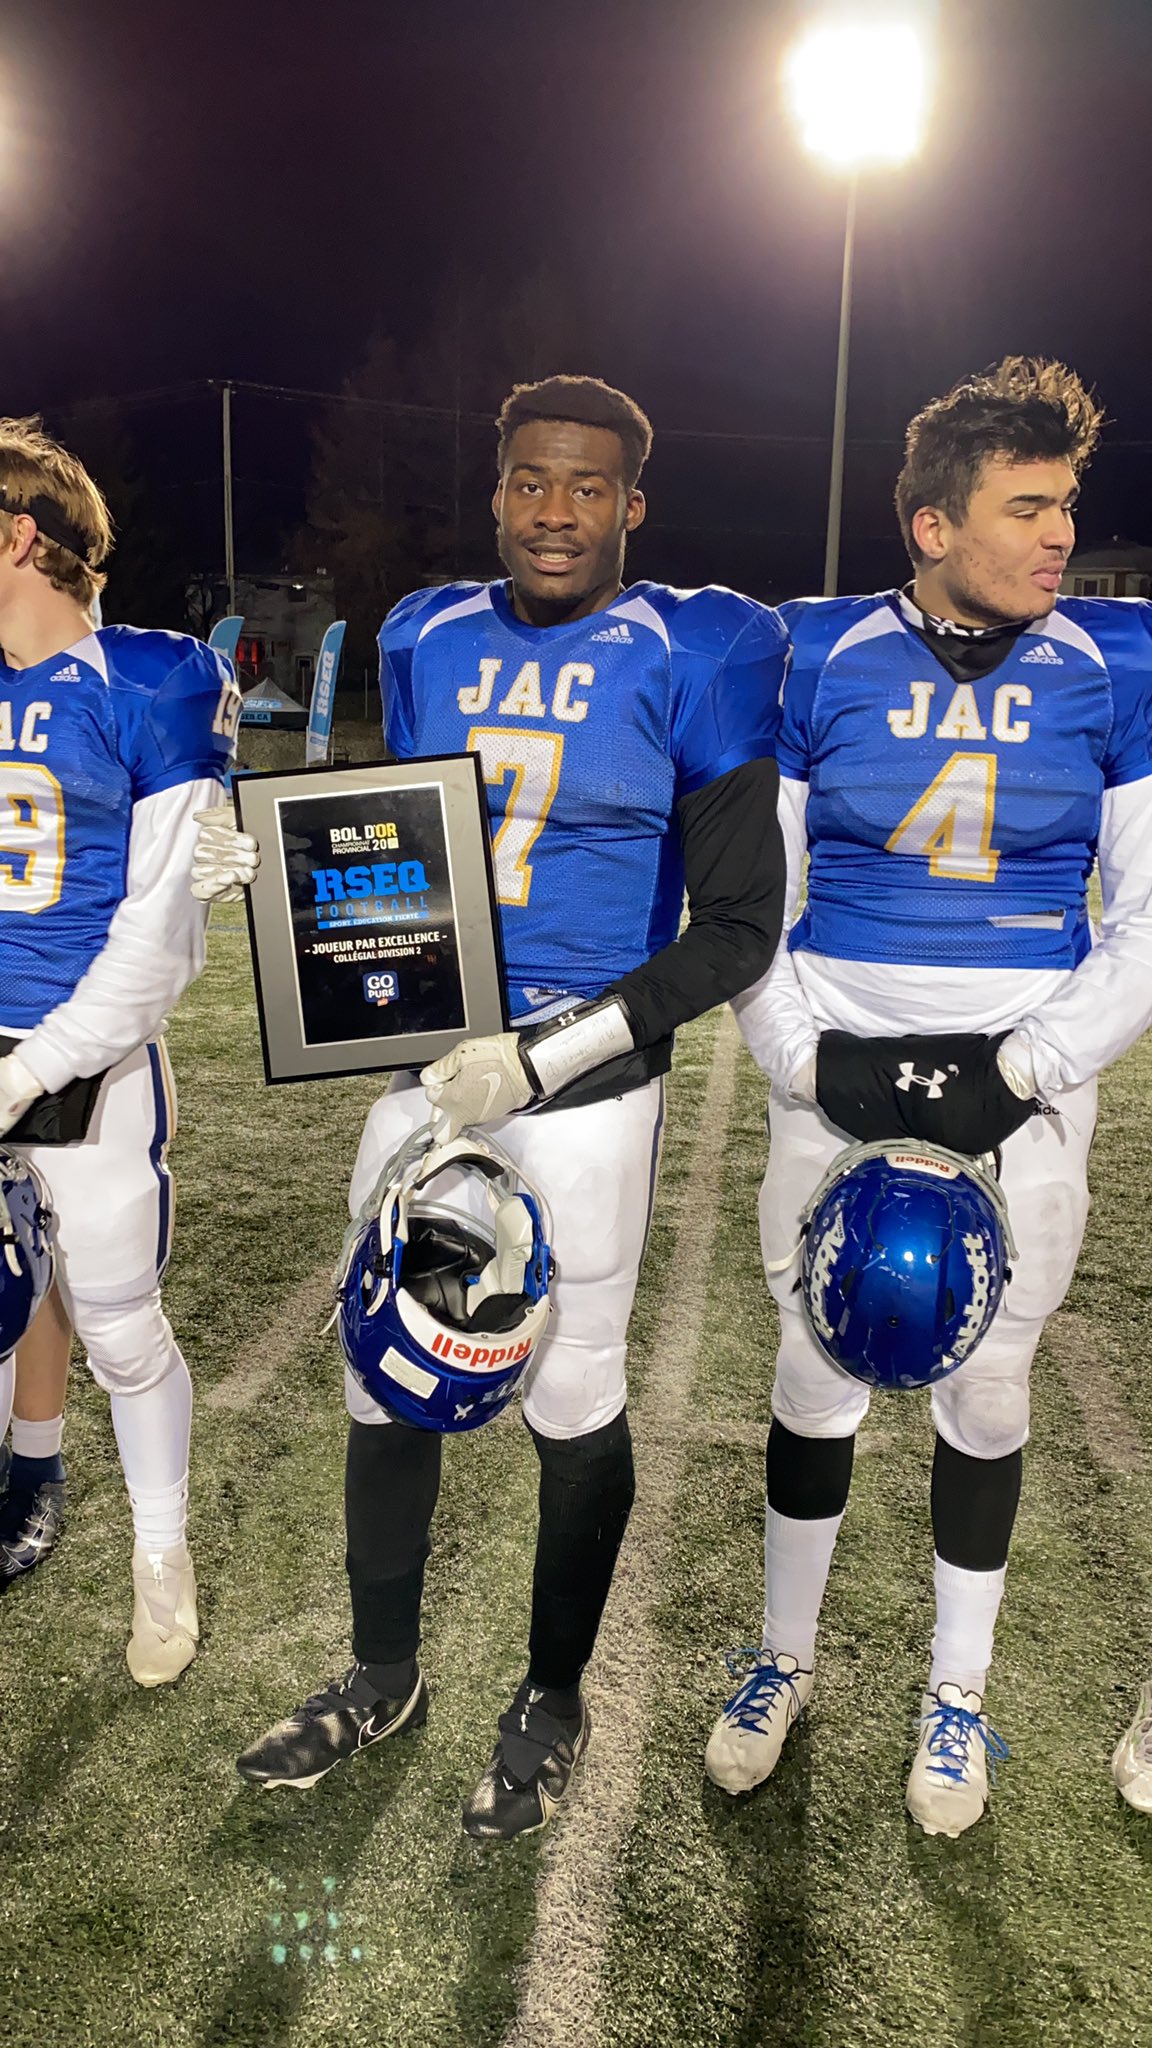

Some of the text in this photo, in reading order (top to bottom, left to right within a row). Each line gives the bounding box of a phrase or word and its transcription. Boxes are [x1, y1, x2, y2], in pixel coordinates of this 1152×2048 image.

[590, 633, 635, 645] adidas
[1019, 655, 1064, 665] adidas
[49, 675, 81, 683] adidas
[457, 658, 595, 723] JAC
[887, 681, 1032, 743] JAC
[466, 727, 564, 906] 7
[884, 752, 1001, 883] 4
[329, 822, 398, 843] BOL D'OR
[332, 846, 371, 856] PROVINCIAL
[311, 859, 431, 903] RSEQ
[316, 895, 428, 919] FOOTBALL
[312, 940, 354, 955] JOUEUR
[355, 938, 376, 951] PAR
[379, 931, 440, 948] EXCELLENCE
[333, 946, 421, 963] COLLÉGIAL DIVISION 2
[367, 974, 394, 990] GO
[368, 987, 395, 998] PURE
[895, 1156, 950, 1173] Riddell
[951, 1232, 990, 1356] Abbott
[431, 1333, 532, 1368] Riddell
